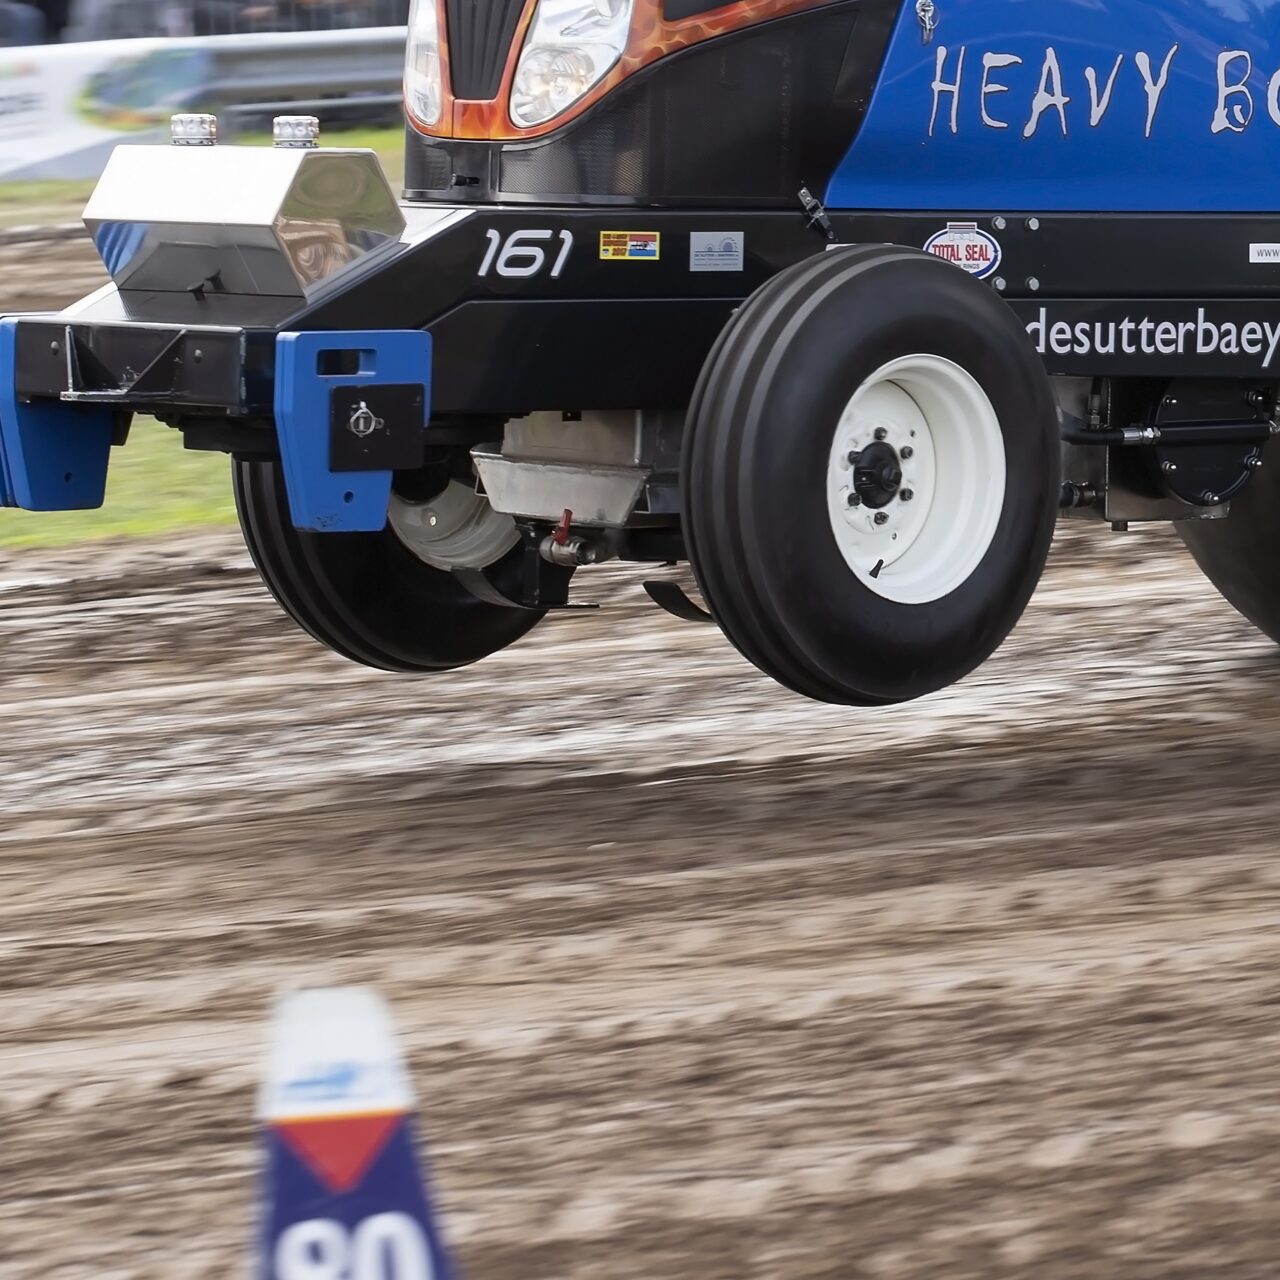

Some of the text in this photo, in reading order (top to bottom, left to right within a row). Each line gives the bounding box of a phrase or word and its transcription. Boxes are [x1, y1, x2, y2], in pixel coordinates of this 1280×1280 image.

[927, 41, 1179, 140] HEAVY
[477, 228, 574, 278] 161
[931, 244, 991, 261] TOTAL SEAL
